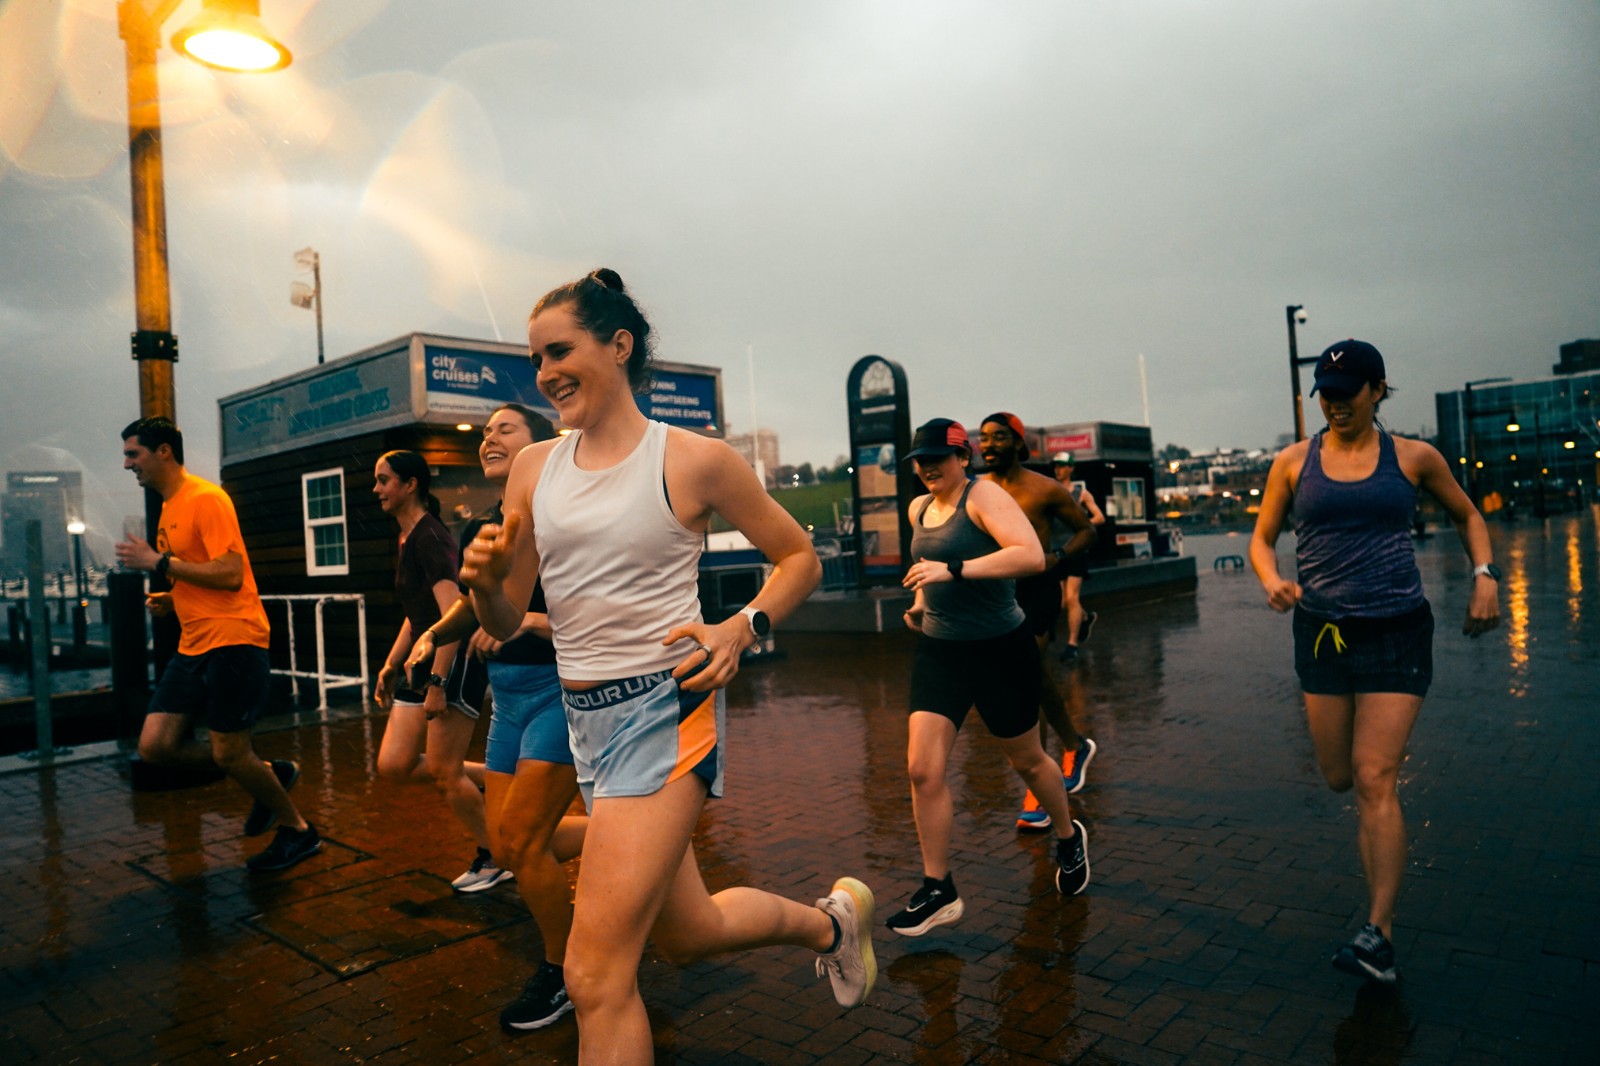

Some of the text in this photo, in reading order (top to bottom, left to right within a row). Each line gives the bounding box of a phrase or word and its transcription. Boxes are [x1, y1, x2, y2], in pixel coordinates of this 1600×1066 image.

[431, 354, 456, 371] city
[432, 369, 479, 384] cruises
[651, 407, 712, 419] PRIVATE EVENTS
